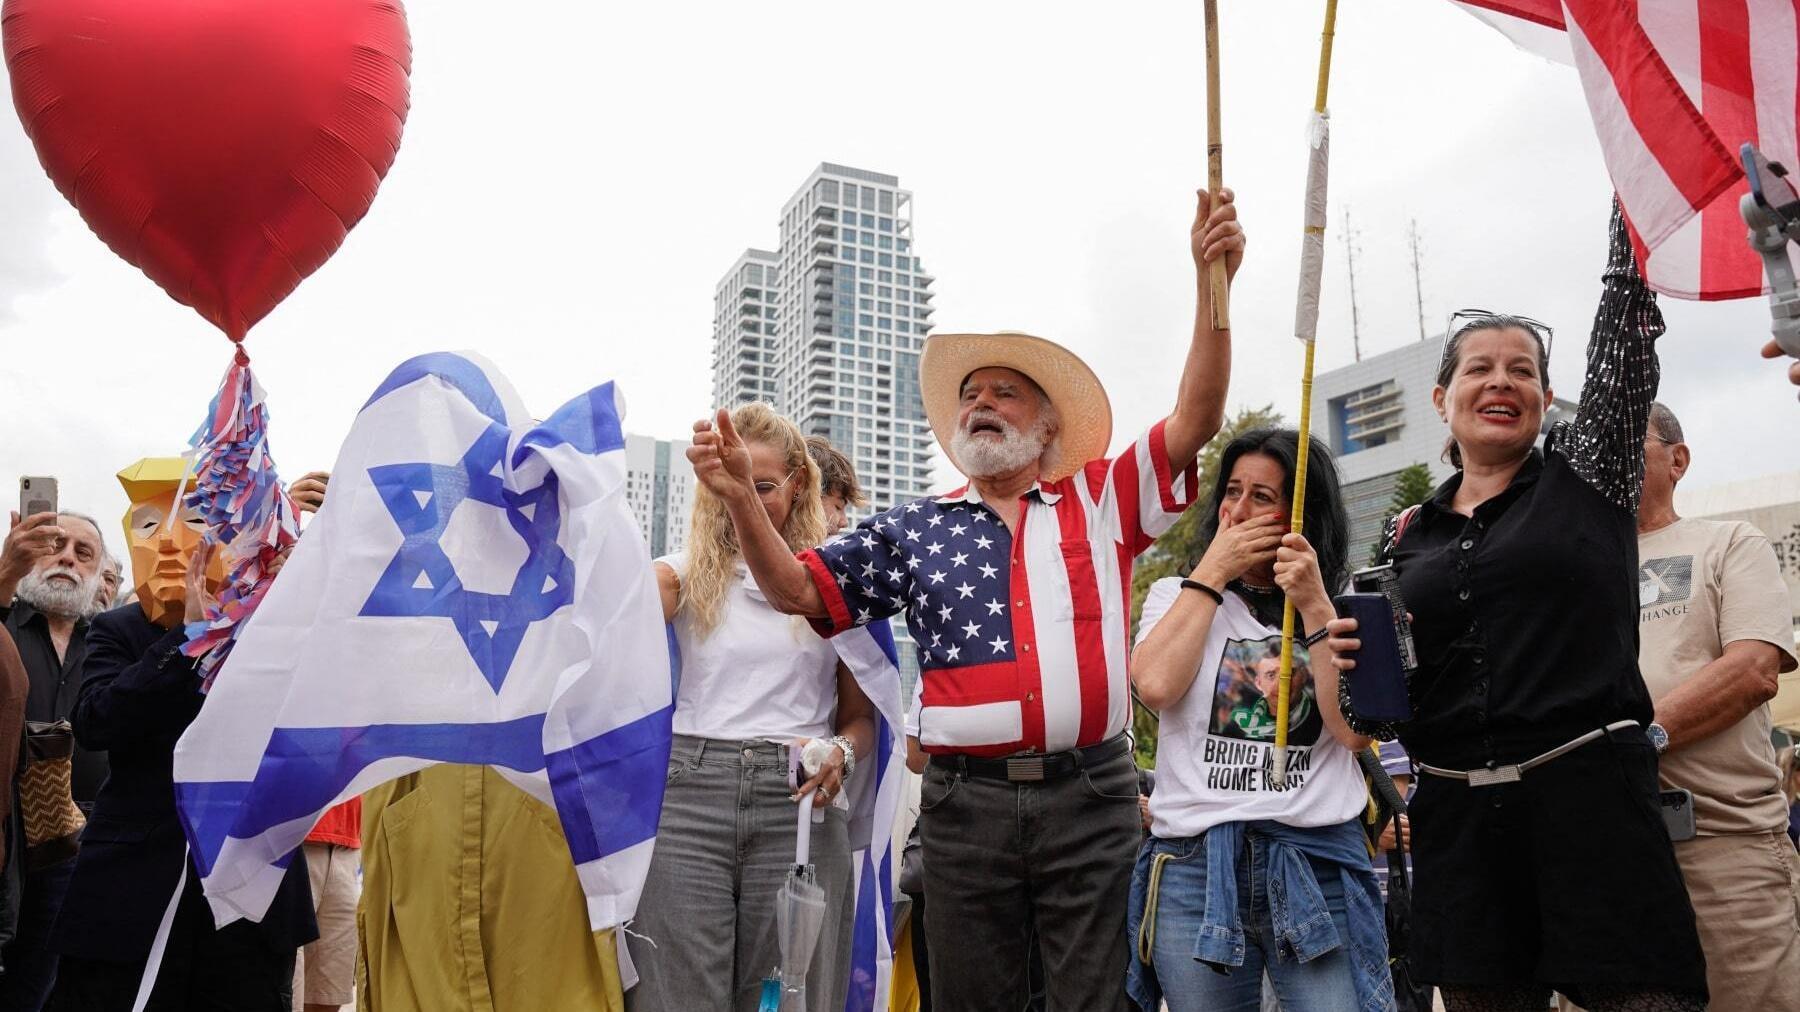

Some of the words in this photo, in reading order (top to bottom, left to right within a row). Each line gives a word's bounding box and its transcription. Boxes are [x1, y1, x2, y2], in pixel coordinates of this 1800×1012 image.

[1642, 604, 1689, 622] HANGE
[1204, 738, 1258, 766] BRING
[1262, 746, 1312, 772] MTAN
[1207, 766, 1257, 792] HOME
